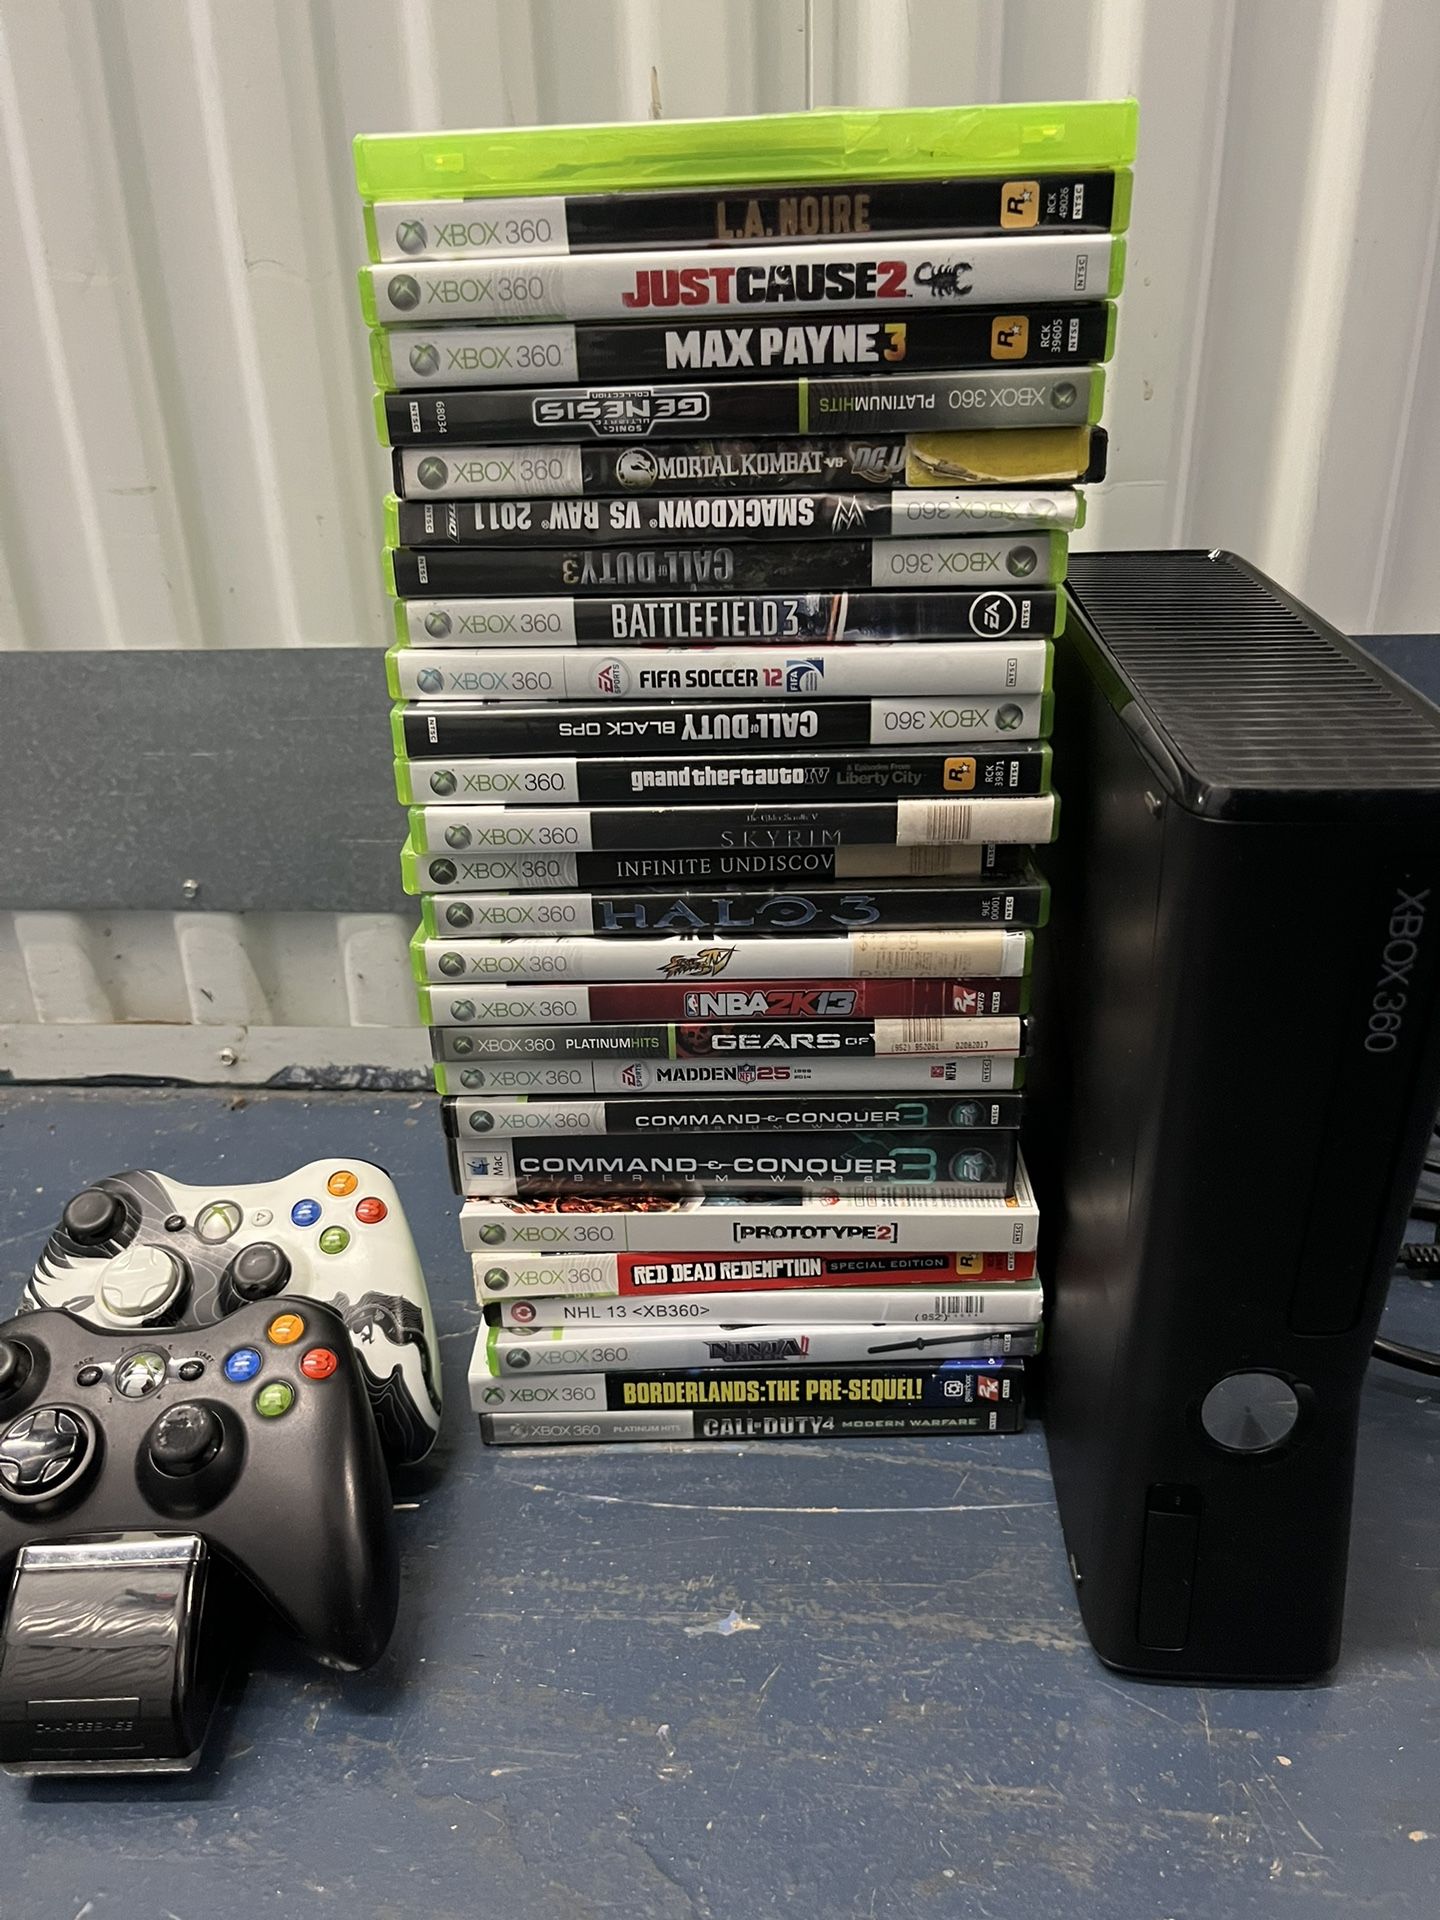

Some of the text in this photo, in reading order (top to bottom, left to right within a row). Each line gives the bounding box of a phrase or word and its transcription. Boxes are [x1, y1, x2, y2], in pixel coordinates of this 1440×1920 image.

[1047, 193, 1056, 214] RCK
[1059, 187, 1069, 218] 49026
[1073, 185, 1084, 218] NTSC
[716, 194, 871, 240] L.A. NOIRE
[434, 219, 551, 247] XBOX 360
[1077, 257, 1087, 289] NTSC
[426, 277, 544, 303] XBOX 360
[1040, 326, 1050, 348] RCK
[1052, 319, 1062, 352] 39605
[1069, 320, 1079, 350] NTSC
[665, 322, 907, 370] MAX PAYNE 3
[447, 344, 563, 371] XBOX 360
[949, 386, 1046, 409] XBOX 360
[411, 403, 420, 432] NTSC
[436, 400, 447, 433] 68034
[540, 400, 702, 420] GENESIS
[454, 459, 562, 483] XBOX 360
[657, 455, 739, 479] MORTAL
[740, 452, 823, 476] KOMBAT
[474, 503, 531, 530] 2011
[610, 501, 641, 529] VS
[658, 498, 814, 530] SMACKDOWN
[907, 500, 1020, 520] XBOX 360
[561, 559, 578, 584] 3
[581, 551, 655, 584] DUTY
[666, 548, 733, 584] CALL
[891, 551, 1000, 574] XBOX 360
[458, 613, 561, 634] XBOX 360
[1022, 602, 1030, 628] NTSC
[450, 671, 552, 691] XBOX 360
[640, 669, 782, 688] FIFA SOCCER 12
[790, 670, 799, 691] FIFA
[559, 723, 600, 736] OPS
[607, 721, 675, 735] BLACK
[681, 713, 750, 740] DUTY
[759, 710, 818, 738] CALL
[884, 709, 989, 730] XBOX 360
[463, 772, 565, 792] XBOX 360
[836, 770, 921, 787] Liberty City
[985, 766, 993, 784] RCK
[477, 827, 578, 846] XBOX 360
[721, 830, 841, 848] SKYRIM
[461, 861, 560, 879] XBOX 360
[617, 853, 835, 877] INFINITE UNDISCOV
[479, 906, 576, 924] XBOX 360
[831, 896, 880, 926] 3
[981, 901, 990, 917] 9UE
[471, 956, 567, 973] XBOX 360
[1364, 888, 1431, 1053] XBOX 360
[481, 1001, 577, 1018] XBOX 360
[478, 1038, 555, 1052] XBOX 360
[711, 1033, 869, 1049] GEARS OF
[489, 1070, 582, 1086] XBOX 360
[657, 1068, 737, 1081] MADDEN
[756, 1067, 791, 1079] 25
[500, 1113, 590, 1128] XBOX 360
[635, 1103, 928, 1127] COMMAND CONQUER 3
[494, 1155, 503, 1176] Mac
[520, 1148, 937, 1184] COMMAND CONQUER 3
[523, 1174, 873, 1183] TIBERIUM WARS
[511, 1226, 614, 1242] XBOX 360
[513, 1268, 601, 1285] XBOX 360
[634, 1259, 943, 1285] RED DEAD REDEMPTION SPECIAL EDITION
[563, 1304, 710, 1319] NHL 13 <XB360>
[195, 1351, 215, 1363] START
[536, 1348, 628, 1365] XBOX 360
[711, 1340, 800, 1358] NINJA
[509, 1387, 595, 1401] XBOX 360
[806, 1378, 922, 1402] PRE-SEQUEL!
[980, 1380, 998, 1398] 2K
[532, 1425, 600, 1436] XBOX 360
[659, 1424, 681, 1432] HITS
[704, 1418, 754, 1436] CALL
[762, 1417, 823, 1434] DUTY
[823, 1417, 835, 1429] 4
[909, 1418, 979, 1426] WARFARE
